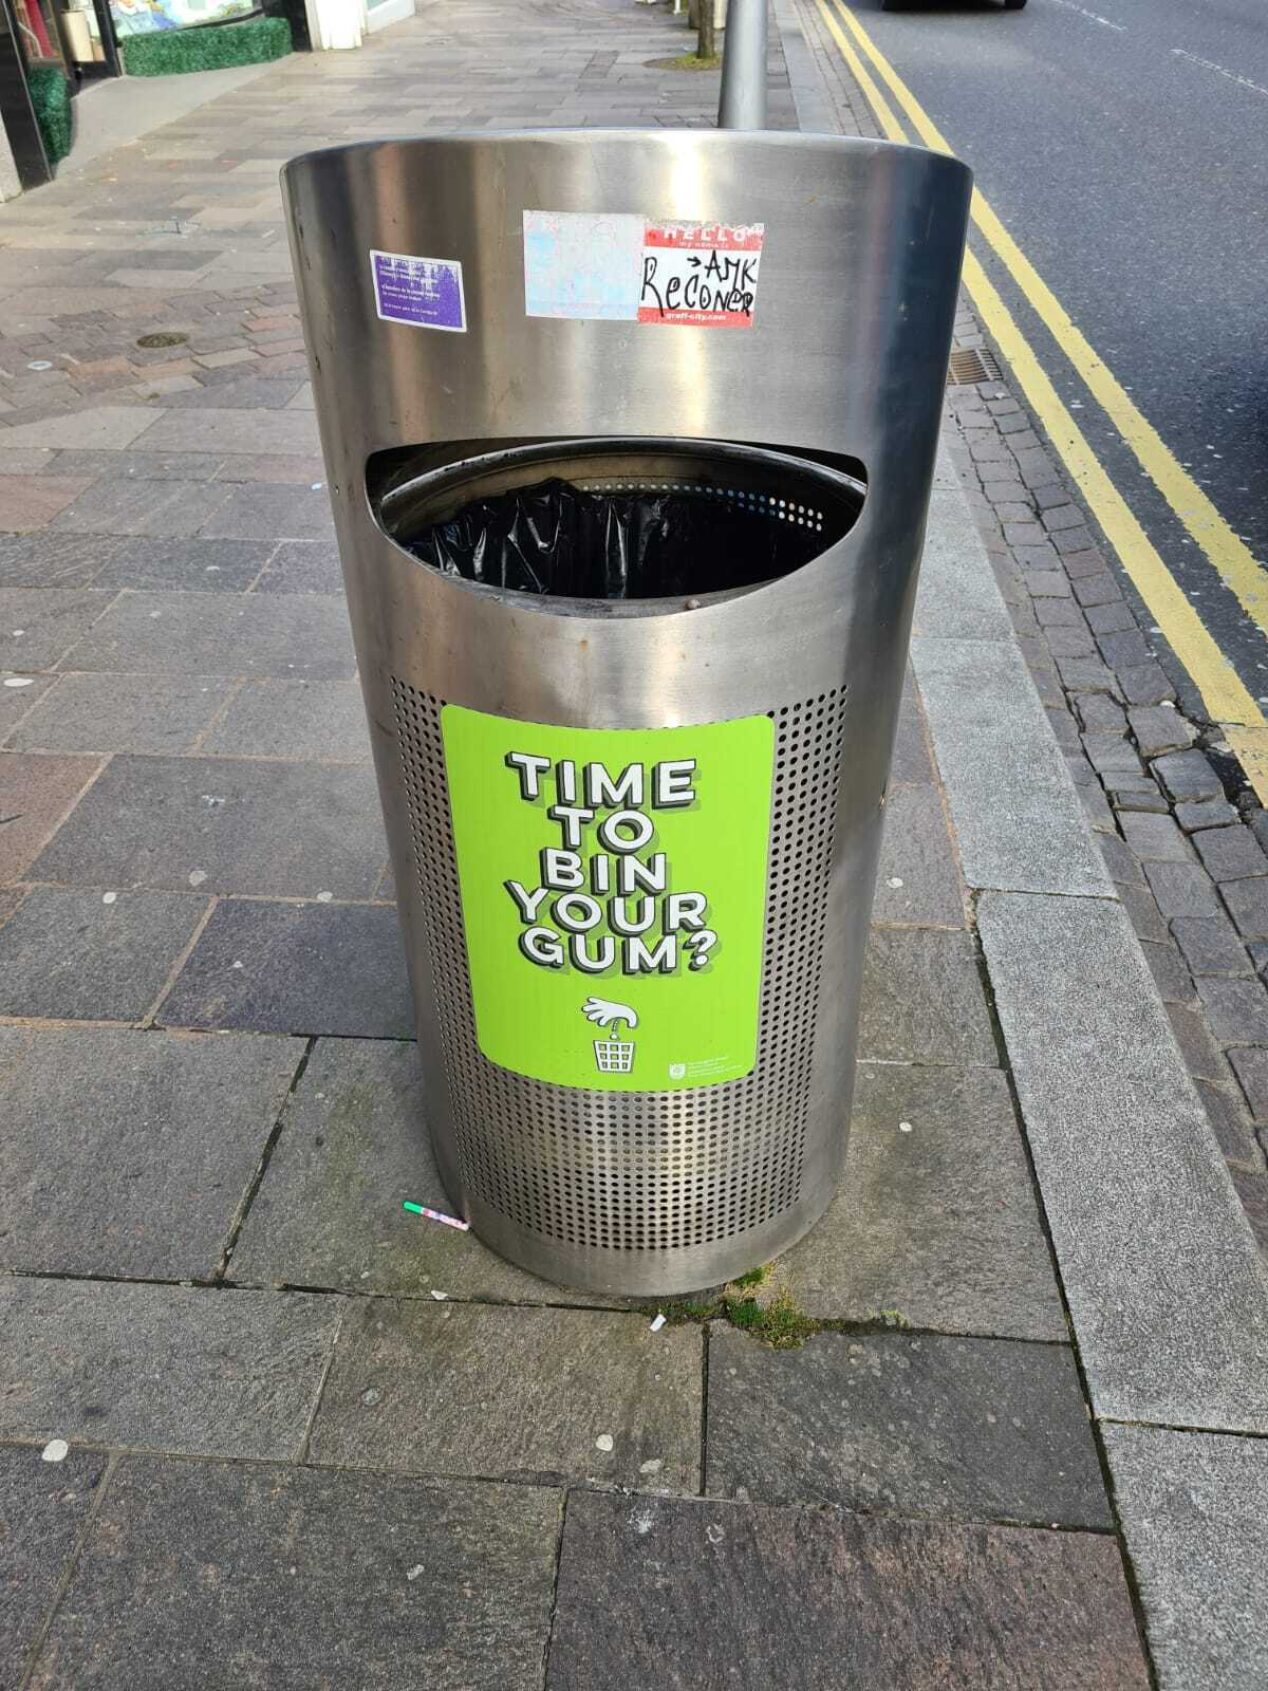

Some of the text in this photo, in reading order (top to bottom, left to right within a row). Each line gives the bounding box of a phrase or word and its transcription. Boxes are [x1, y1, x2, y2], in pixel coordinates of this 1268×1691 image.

[505, 751, 696, 810] TIME
[547, 804, 654, 854] TO
[539, 847, 667, 896] BIN
[503, 879, 708, 937] YOUR
[518, 926, 718, 976] GUM?
